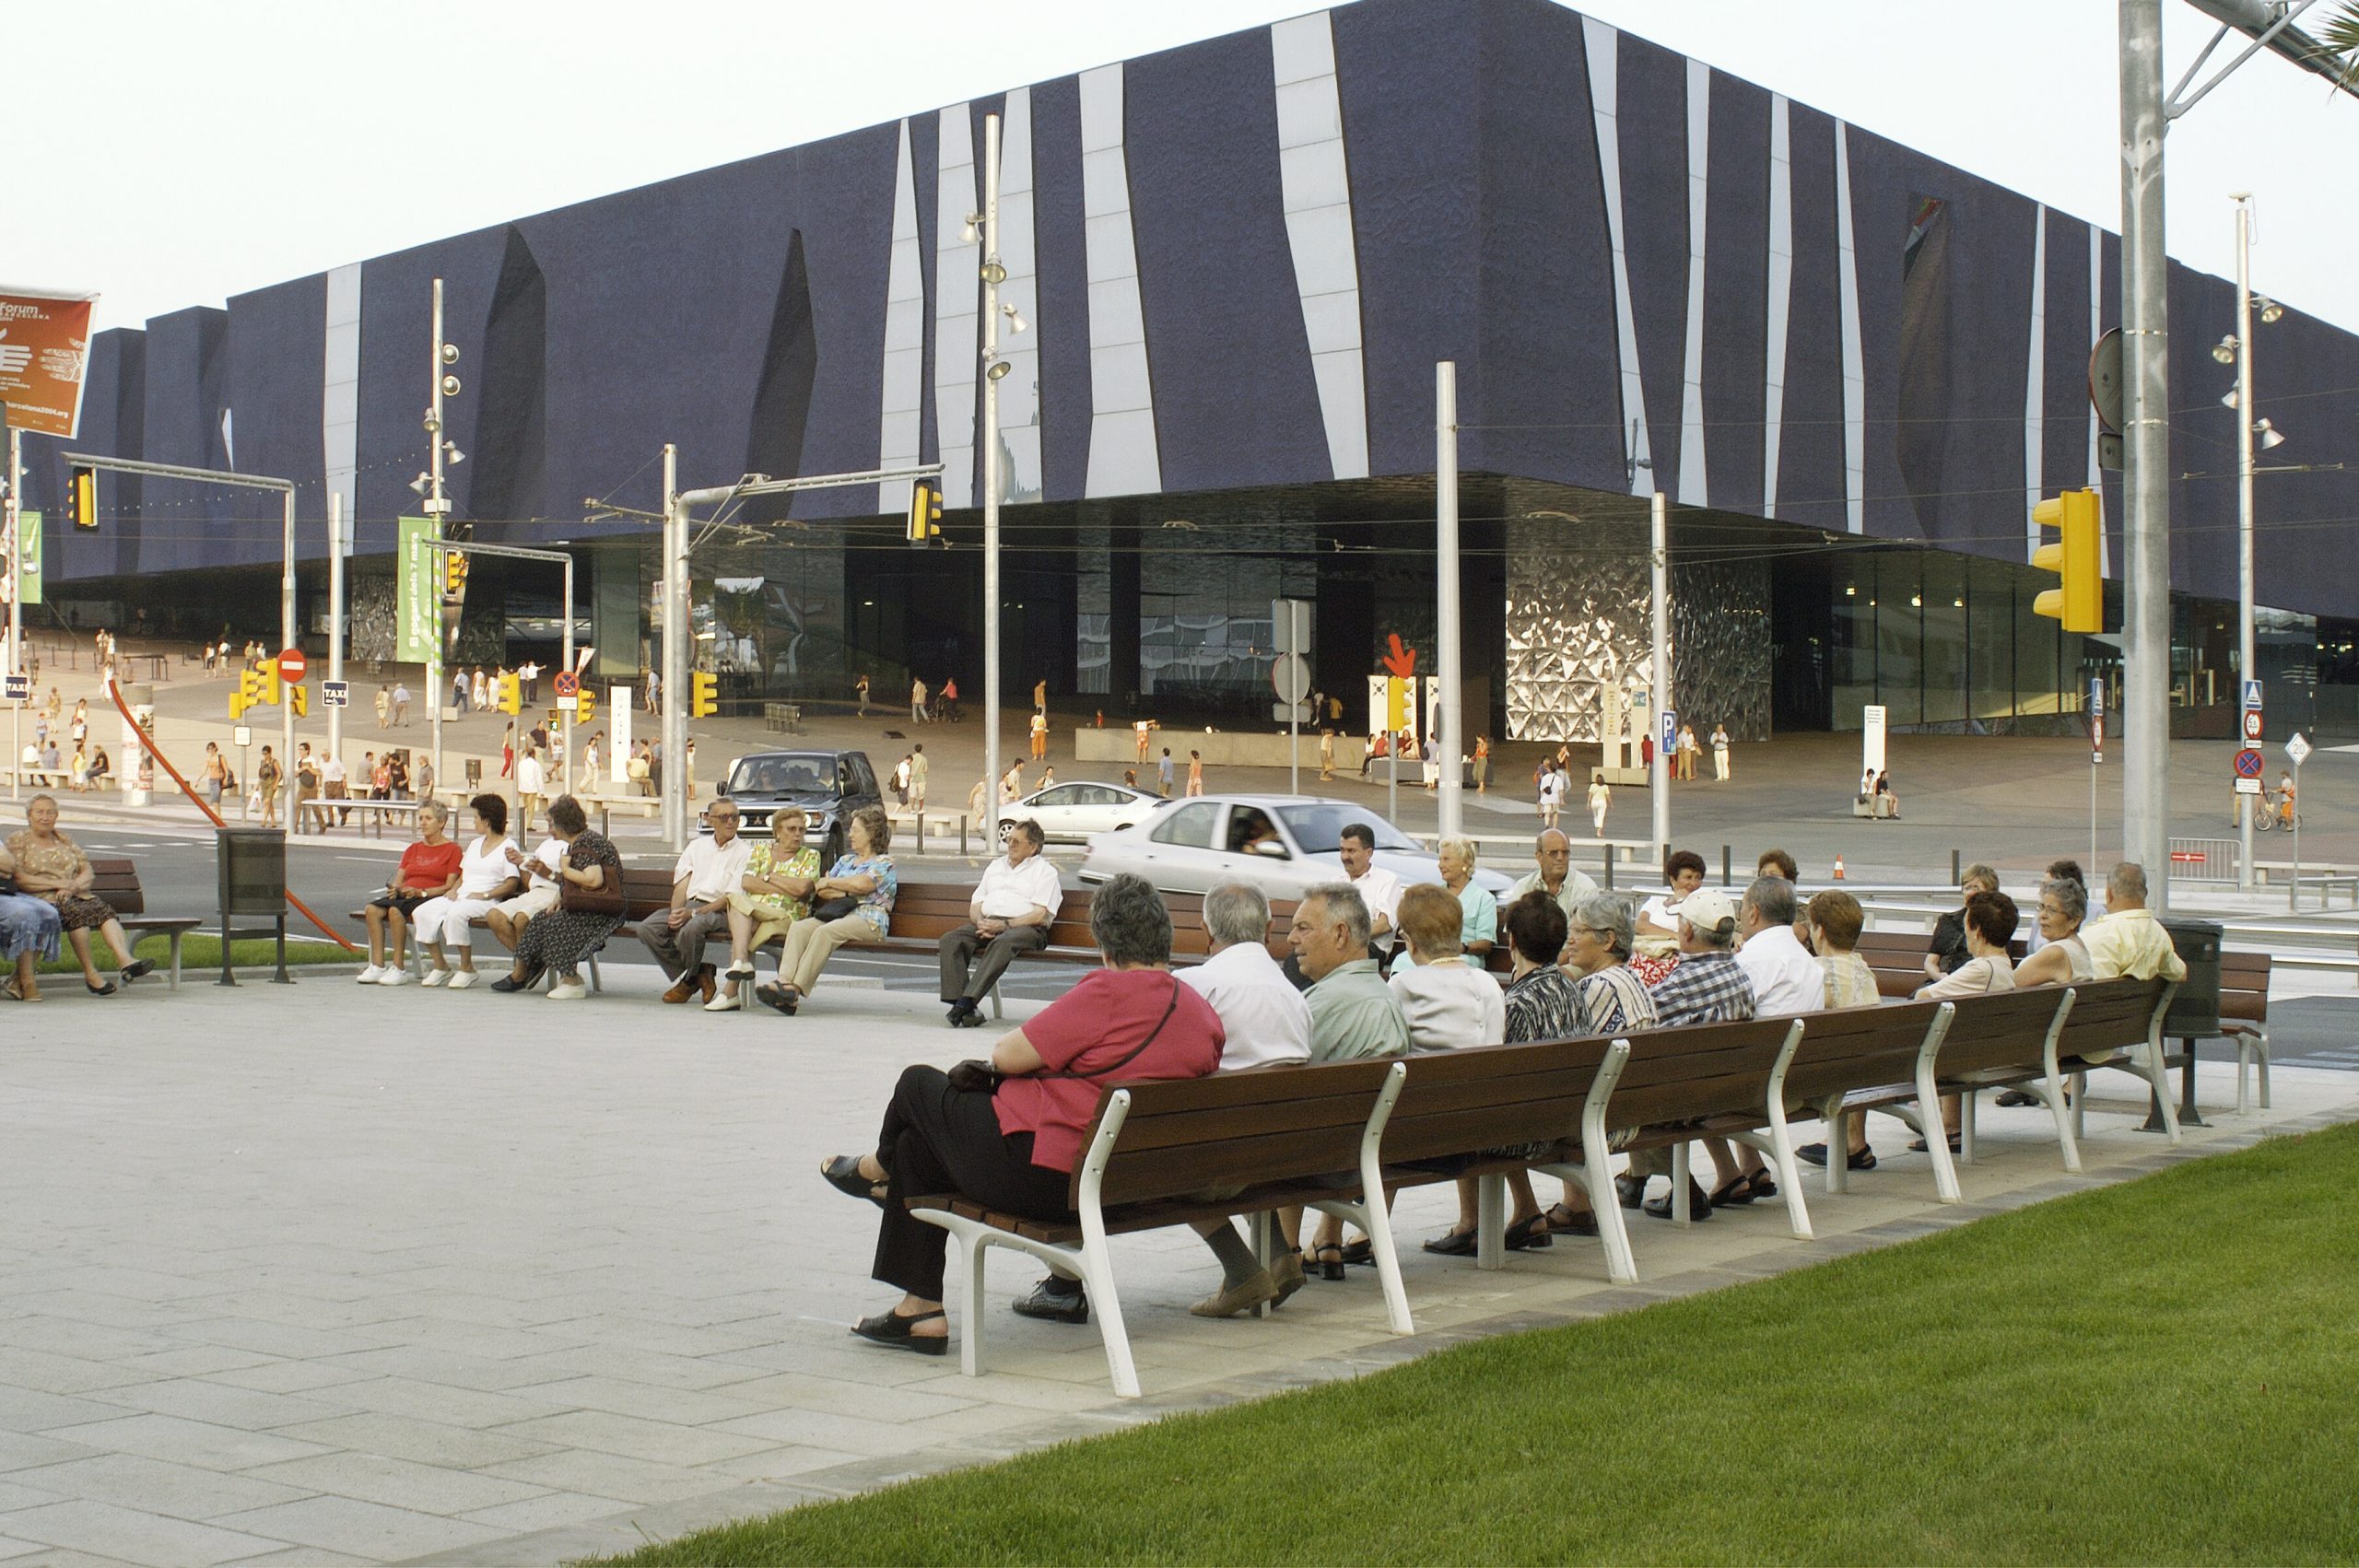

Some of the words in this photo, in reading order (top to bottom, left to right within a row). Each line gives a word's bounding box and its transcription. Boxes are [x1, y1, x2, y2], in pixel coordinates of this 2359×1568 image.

[410, 562, 417, 571] 7
[6, 683, 28, 692] TAXI
[324, 689, 347, 698] TAXI
[1663, 715, 1673, 738] P
[2293, 743, 2306, 755] 20
